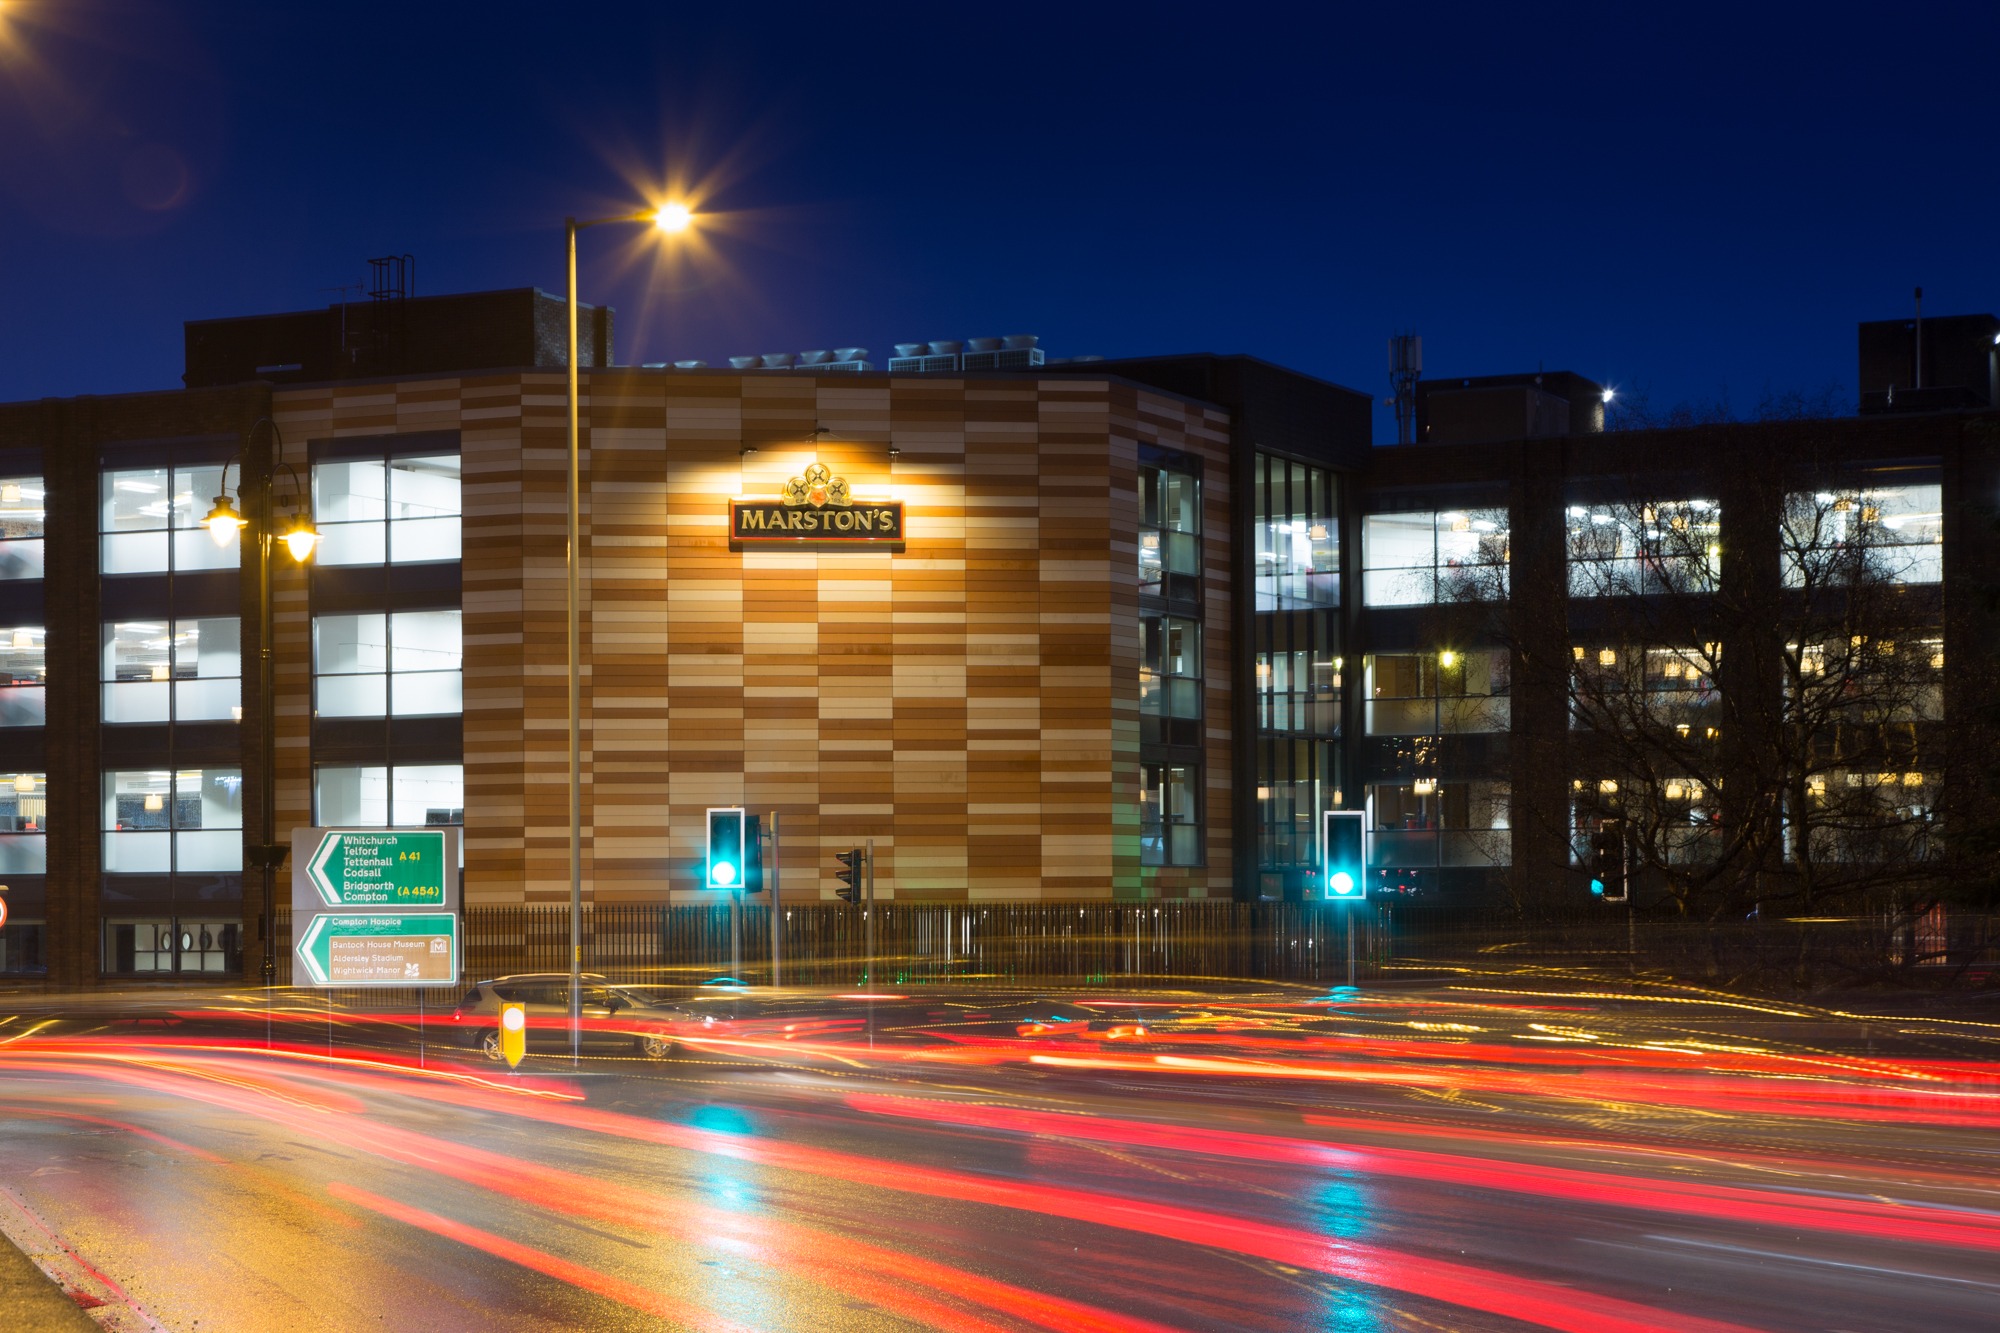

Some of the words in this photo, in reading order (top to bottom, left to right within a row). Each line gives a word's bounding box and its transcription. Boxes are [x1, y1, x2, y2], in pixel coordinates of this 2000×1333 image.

[741, 509, 894, 530] MARSTON'S
[343, 836, 398, 844] Whitchurch
[343, 847, 378, 855] Telford
[399, 852, 407, 861] A
[408, 852, 421, 861] 41
[343, 858, 393, 866] Tettenhall
[343, 868, 382, 877] Codsall
[343, 882, 394, 891] Bridgnorth
[343, 892, 388, 901] Compton
[397, 887, 410, 897] (A
[411, 887, 439, 897] 454)
[332, 918, 368, 927] Compton
[370, 918, 402, 926] Hospice
[393, 940, 426, 948] Museum
[333, 955, 370, 963] Aldersley
[372, 954, 404, 962] Stadium
[333, 967, 374, 976] Wightwick
[376, 966, 401, 974] Manor
